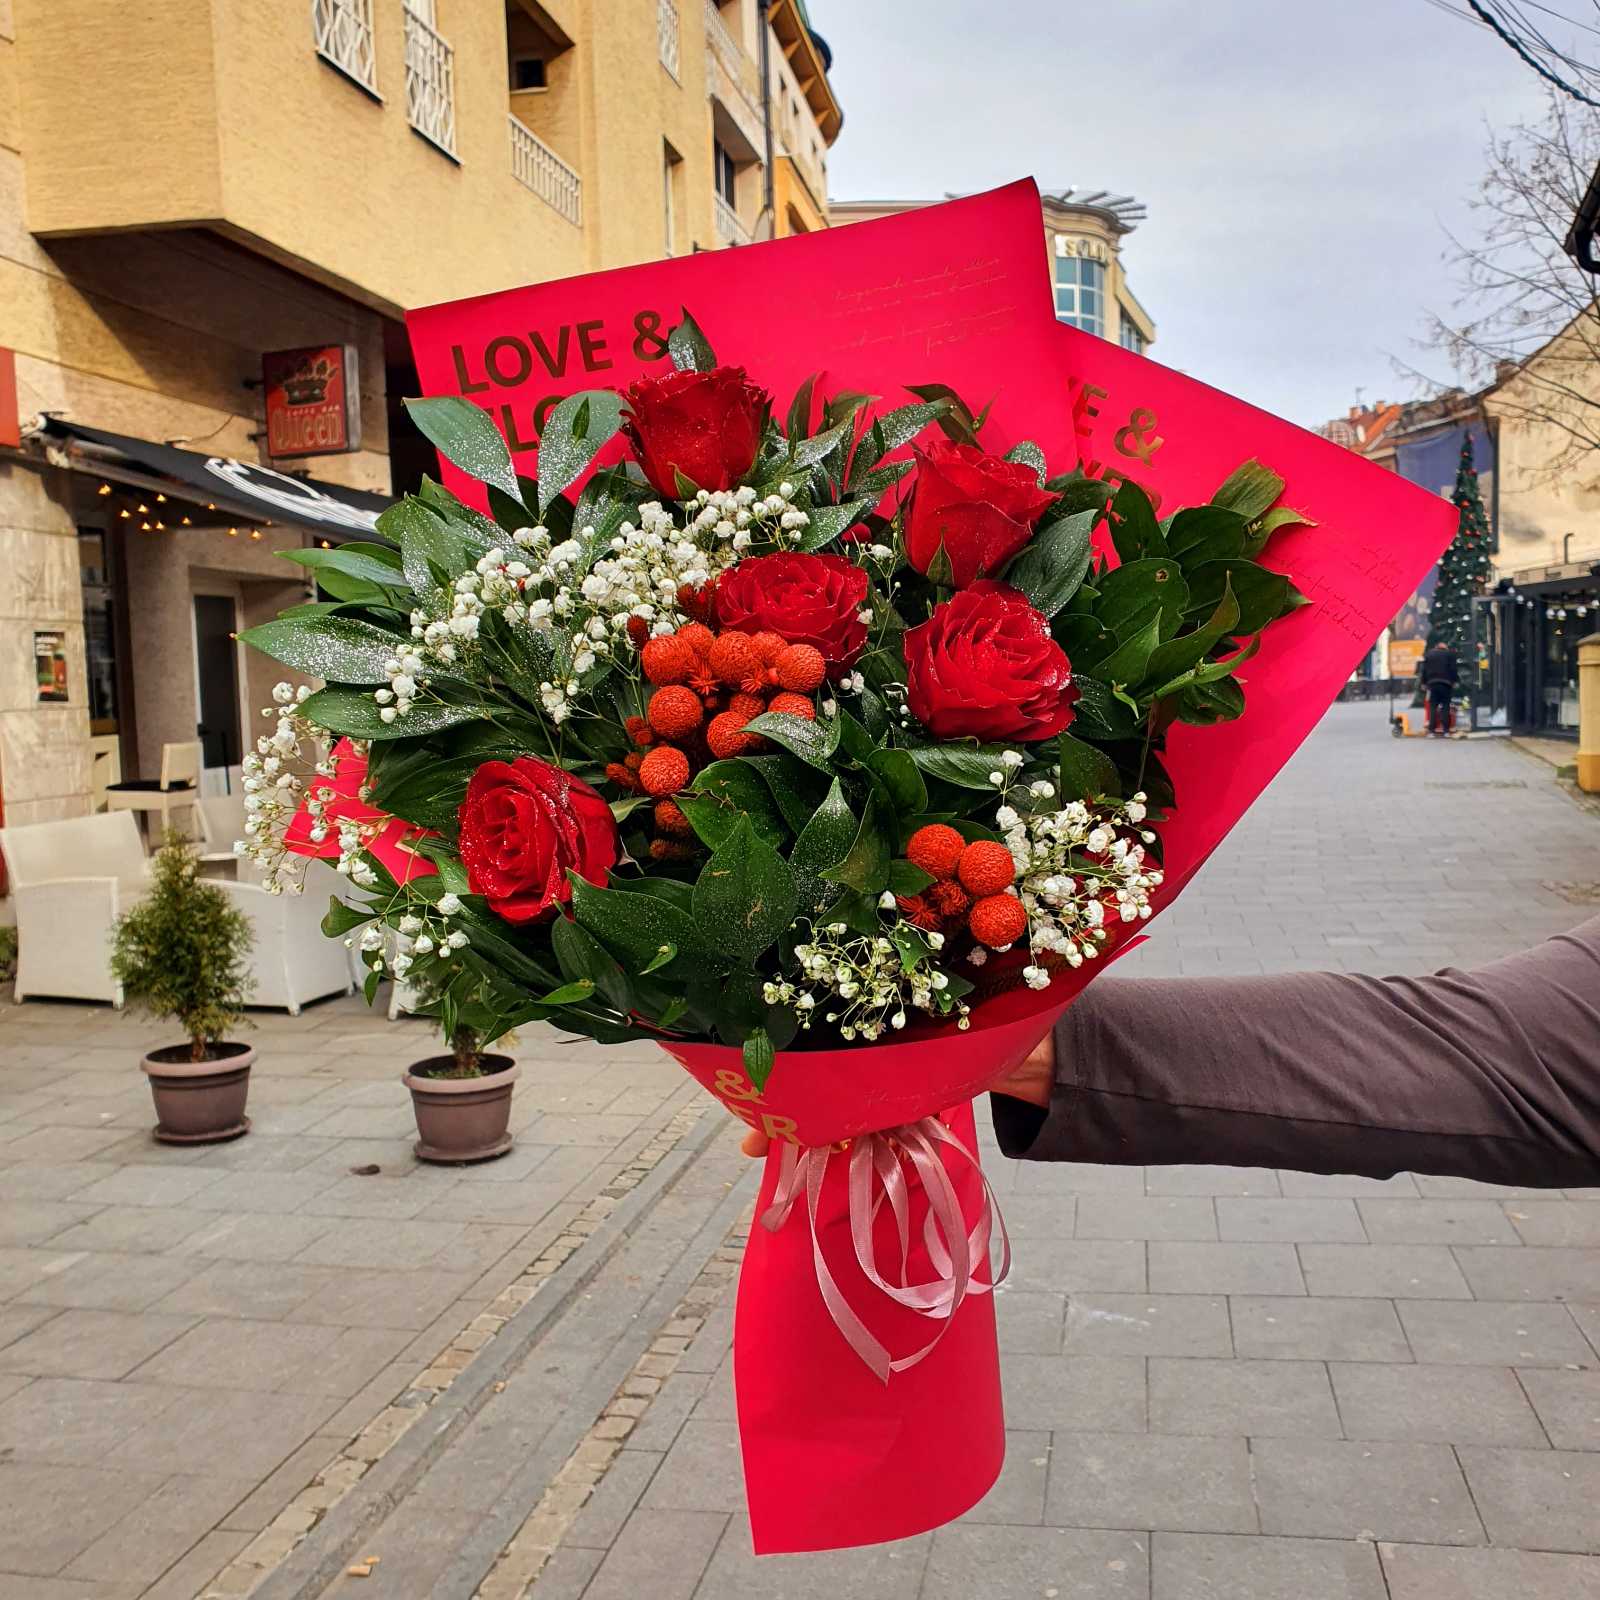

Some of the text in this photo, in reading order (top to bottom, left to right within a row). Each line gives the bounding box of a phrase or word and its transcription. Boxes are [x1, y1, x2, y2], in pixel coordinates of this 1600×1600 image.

[451, 309, 678, 395] LOVE &
[1114, 407, 1165, 466] &
[714, 1068, 769, 1106] &
